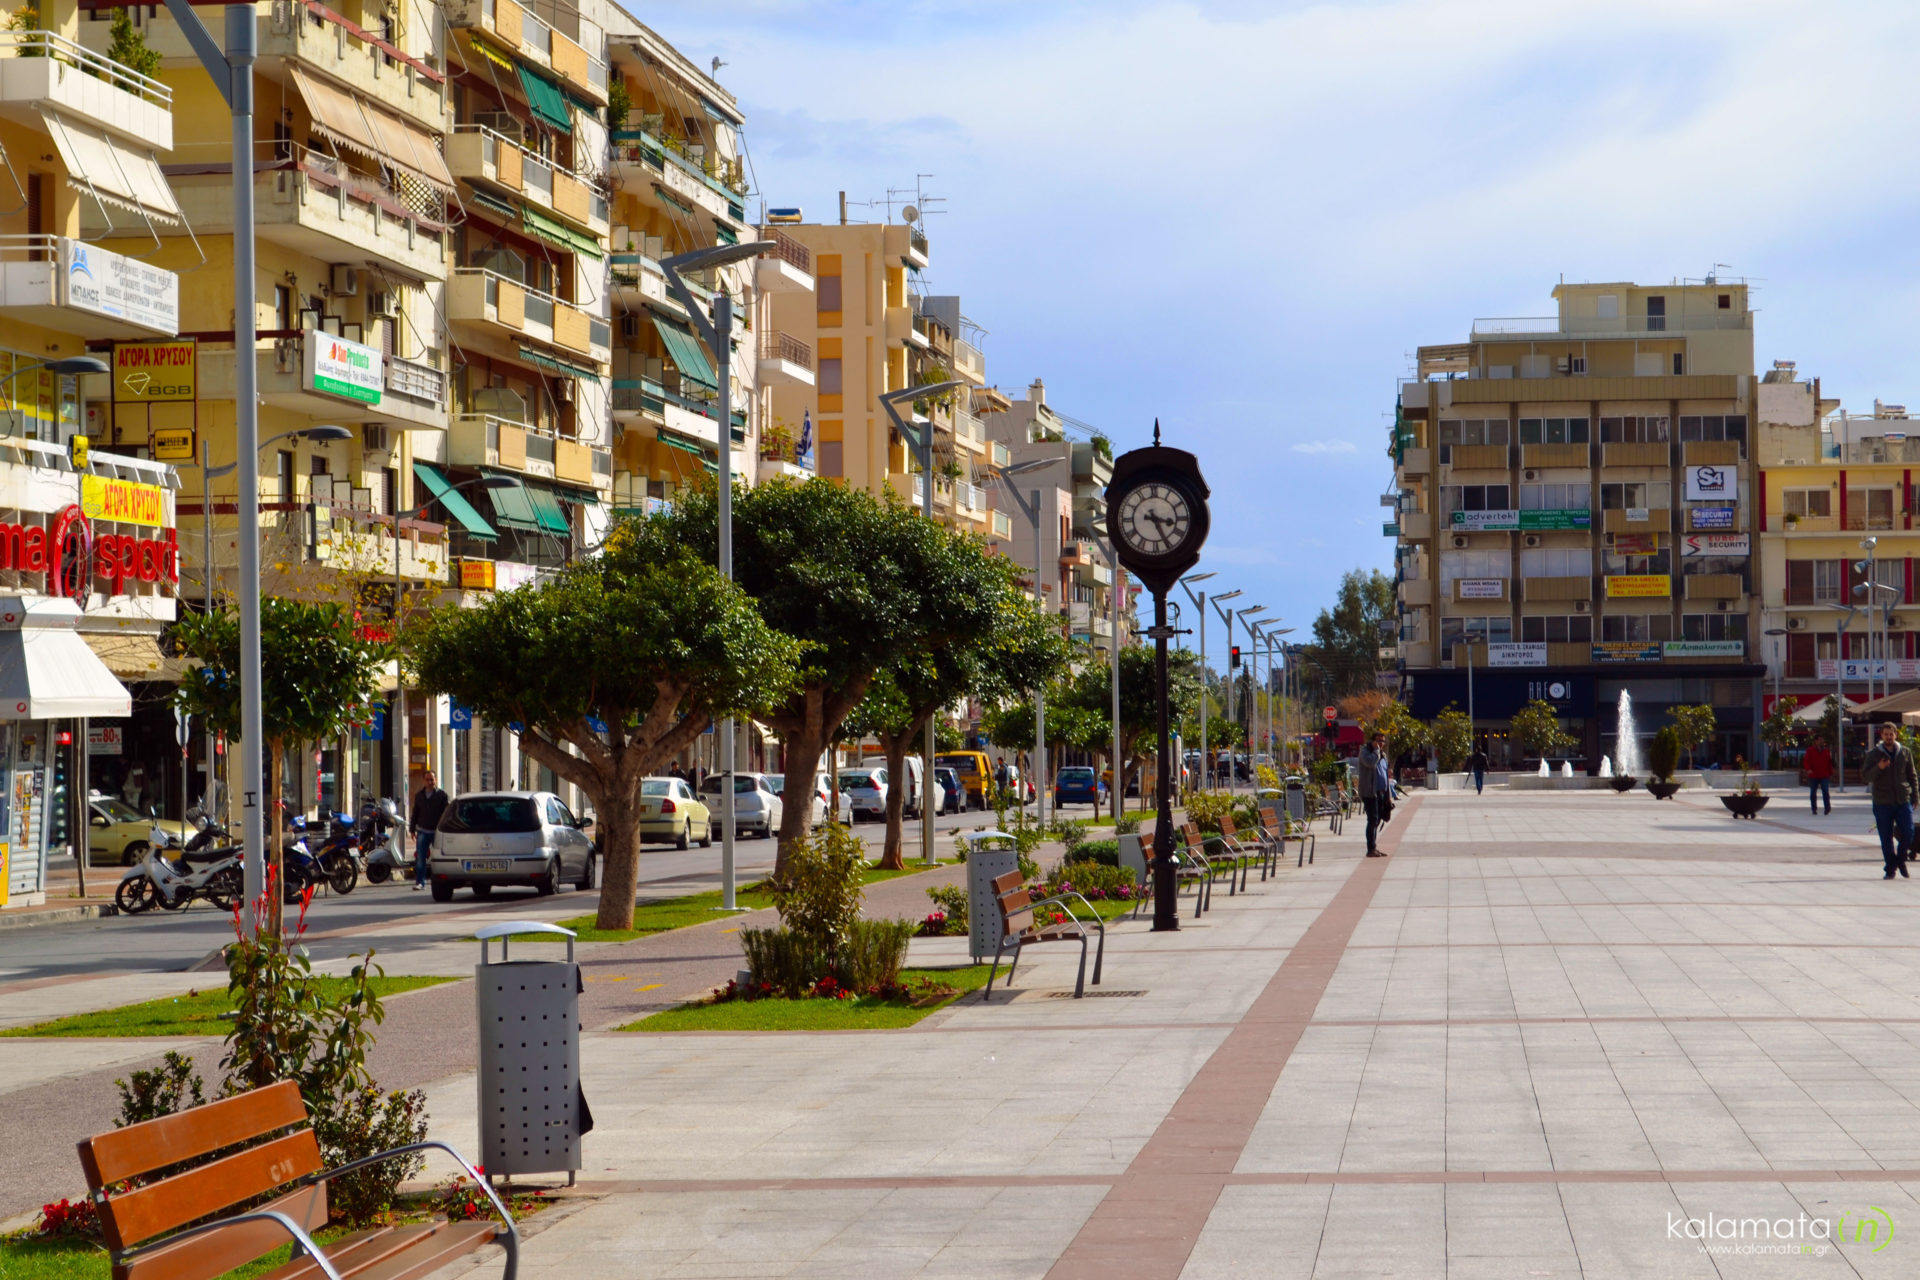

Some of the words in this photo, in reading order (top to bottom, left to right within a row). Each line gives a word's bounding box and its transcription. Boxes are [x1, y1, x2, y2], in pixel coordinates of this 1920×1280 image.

[118, 347, 151, 367] ΑΓΟΡΑ
[153, 346, 192, 366] ΧΡΥΣΟΥ
[148, 385, 191, 395] BGB
[104, 483, 128, 518] ΑΓΟΡΑ
[131, 487, 160, 522] ΧΡΥΣΟΥ
[100, 527, 179, 595] sport
